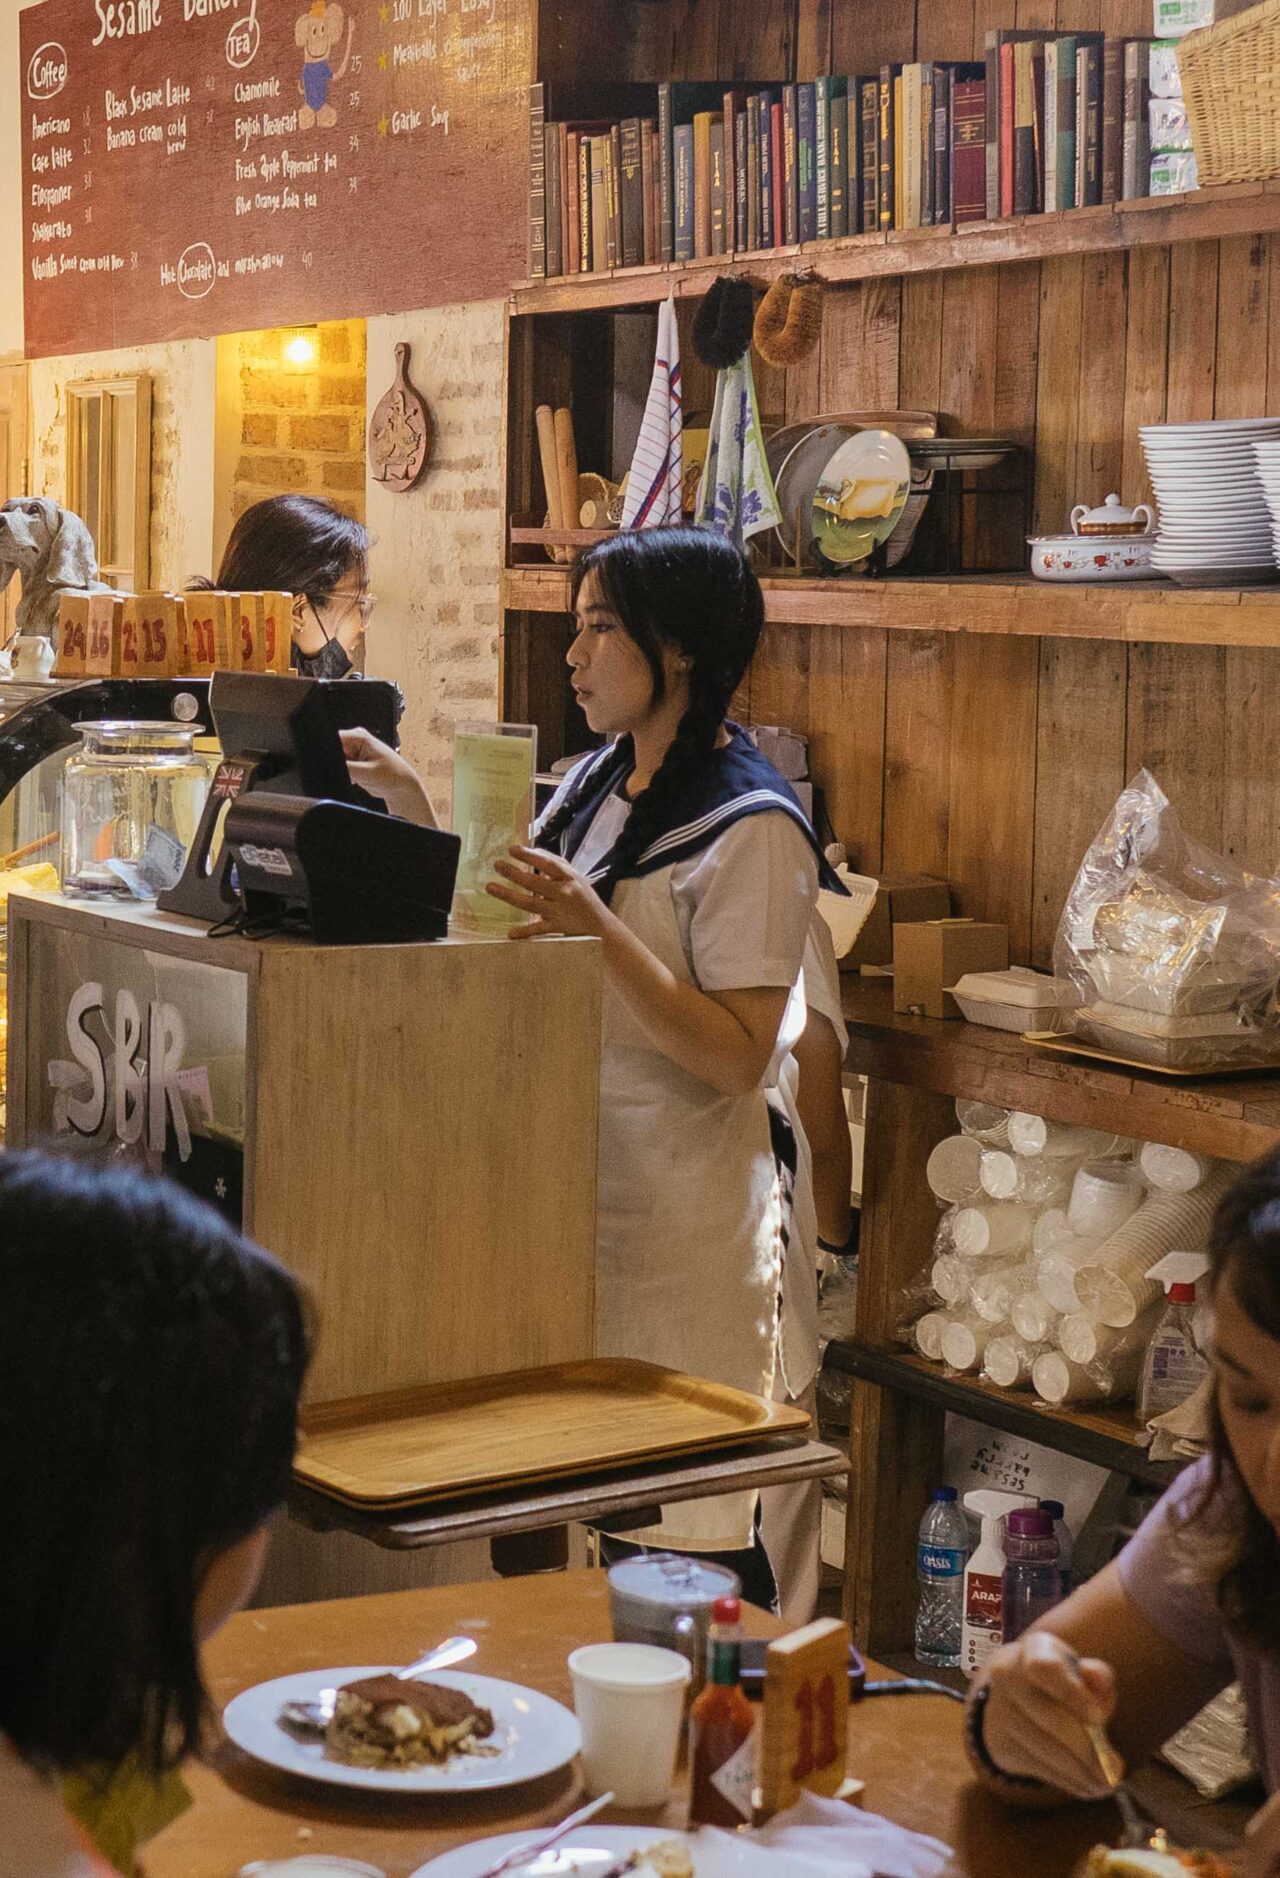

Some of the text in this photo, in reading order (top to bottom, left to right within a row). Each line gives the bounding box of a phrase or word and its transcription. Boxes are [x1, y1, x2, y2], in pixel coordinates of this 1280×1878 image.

[33, 57, 66, 88] Coffee
[105, 89, 127, 121] Black
[130, 85, 163, 116] Sesame
[166, 78, 191, 108] Latte
[234, 77, 281, 103] Chamomile
[32, 113, 71, 141] Americano
[106, 126, 136, 152] Banana
[139, 124, 163, 143] cream
[167, 115, 187, 137] cold
[235, 114, 261, 152] English
[392, 108, 421, 134] Garlic
[235, 159, 257, 181] Fresh
[323, 152, 337, 173] tea
[817, 140, 826, 167] BANK
[817, 168, 826, 204] SERVICE
[235, 196, 252, 216] Blue
[255, 193, 280, 214] Orange
[303, 192, 317, 208] tea
[818, 207, 827, 228] FULL
[32, 253, 58, 281] Vanilla
[160, 263, 176, 287] Hot
[217, 260, 230, 277] and
[63, 619, 87, 660] 24
[90, 618, 109, 658] 16
[123, 620, 137, 662] 2
[142, 618, 166, 662] 15
[66, 982, 192, 1162] SBR
[923, 1554, 951, 1569] OASIS
[790, 1674, 838, 1781] 11
